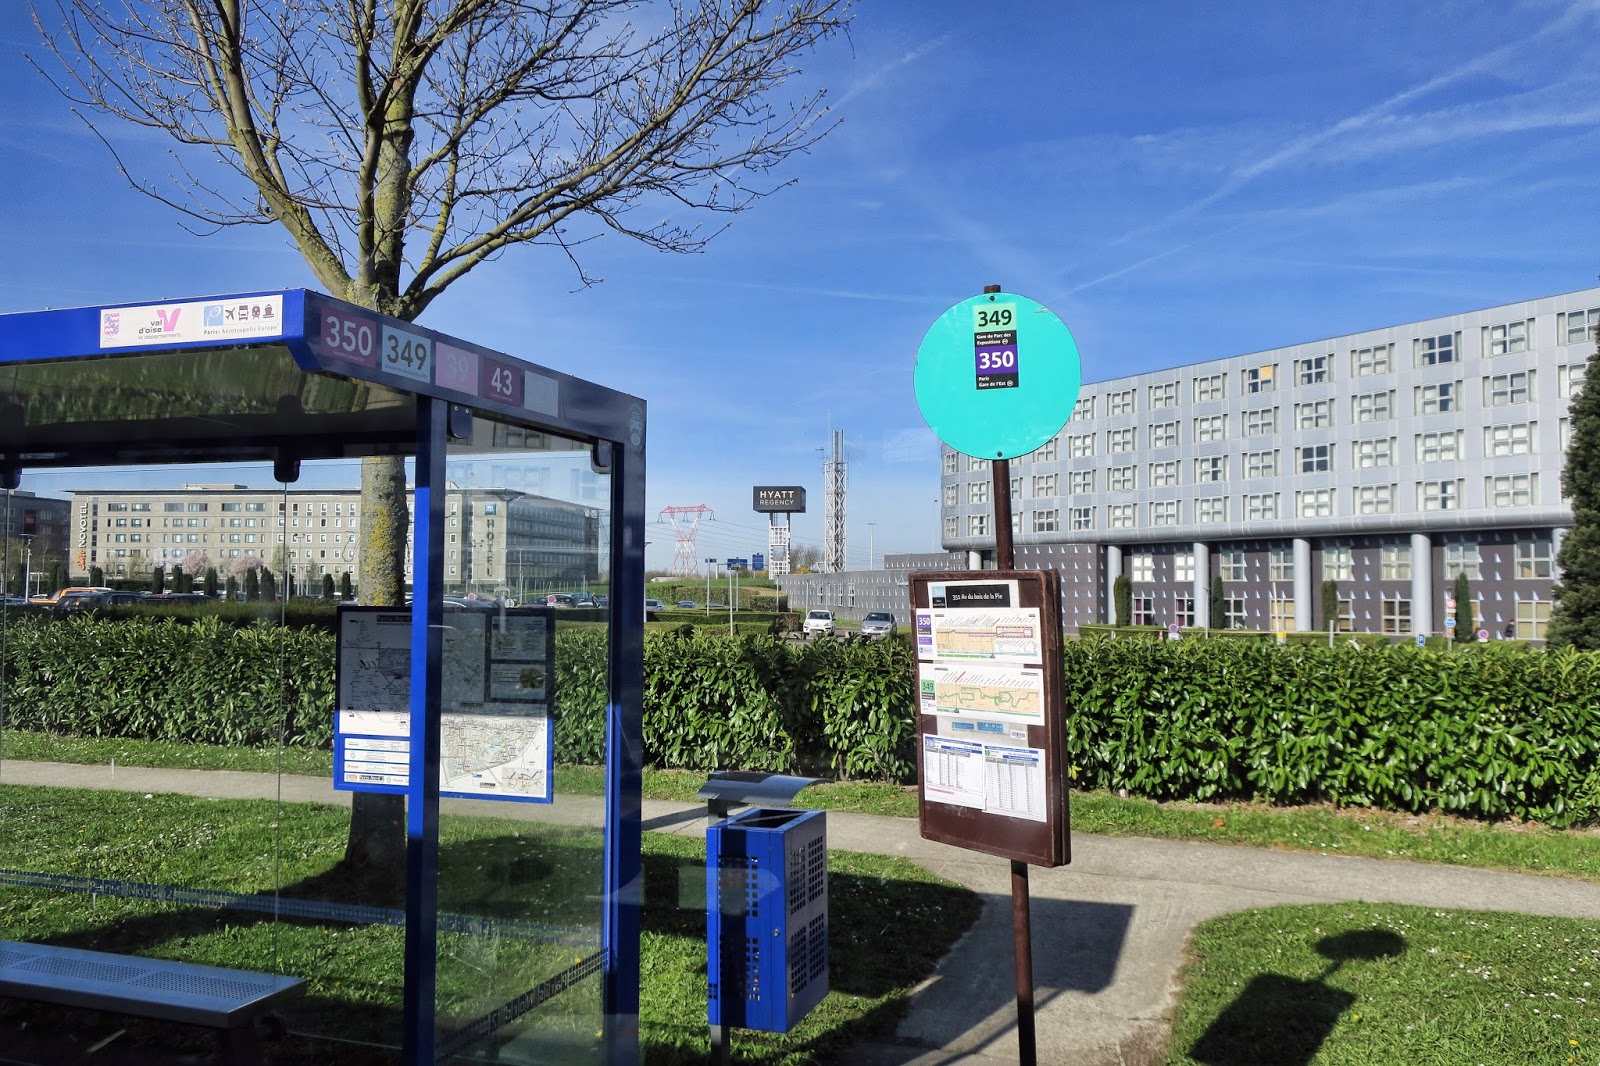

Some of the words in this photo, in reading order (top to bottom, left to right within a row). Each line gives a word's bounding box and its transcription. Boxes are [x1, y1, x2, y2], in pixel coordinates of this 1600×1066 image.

[978, 309, 1012, 327] 349
[326, 315, 372, 356] 350
[386, 334, 427, 370] 349
[979, 350, 1014, 370] 350
[491, 367, 513, 395] 43
[760, 490, 794, 499] HYATT
[78, 502, 88, 548] NOVOTEL
[487, 519, 495, 577] HOTEL
[918, 617, 930, 626] 350
[922, 682, 934, 691] 349
